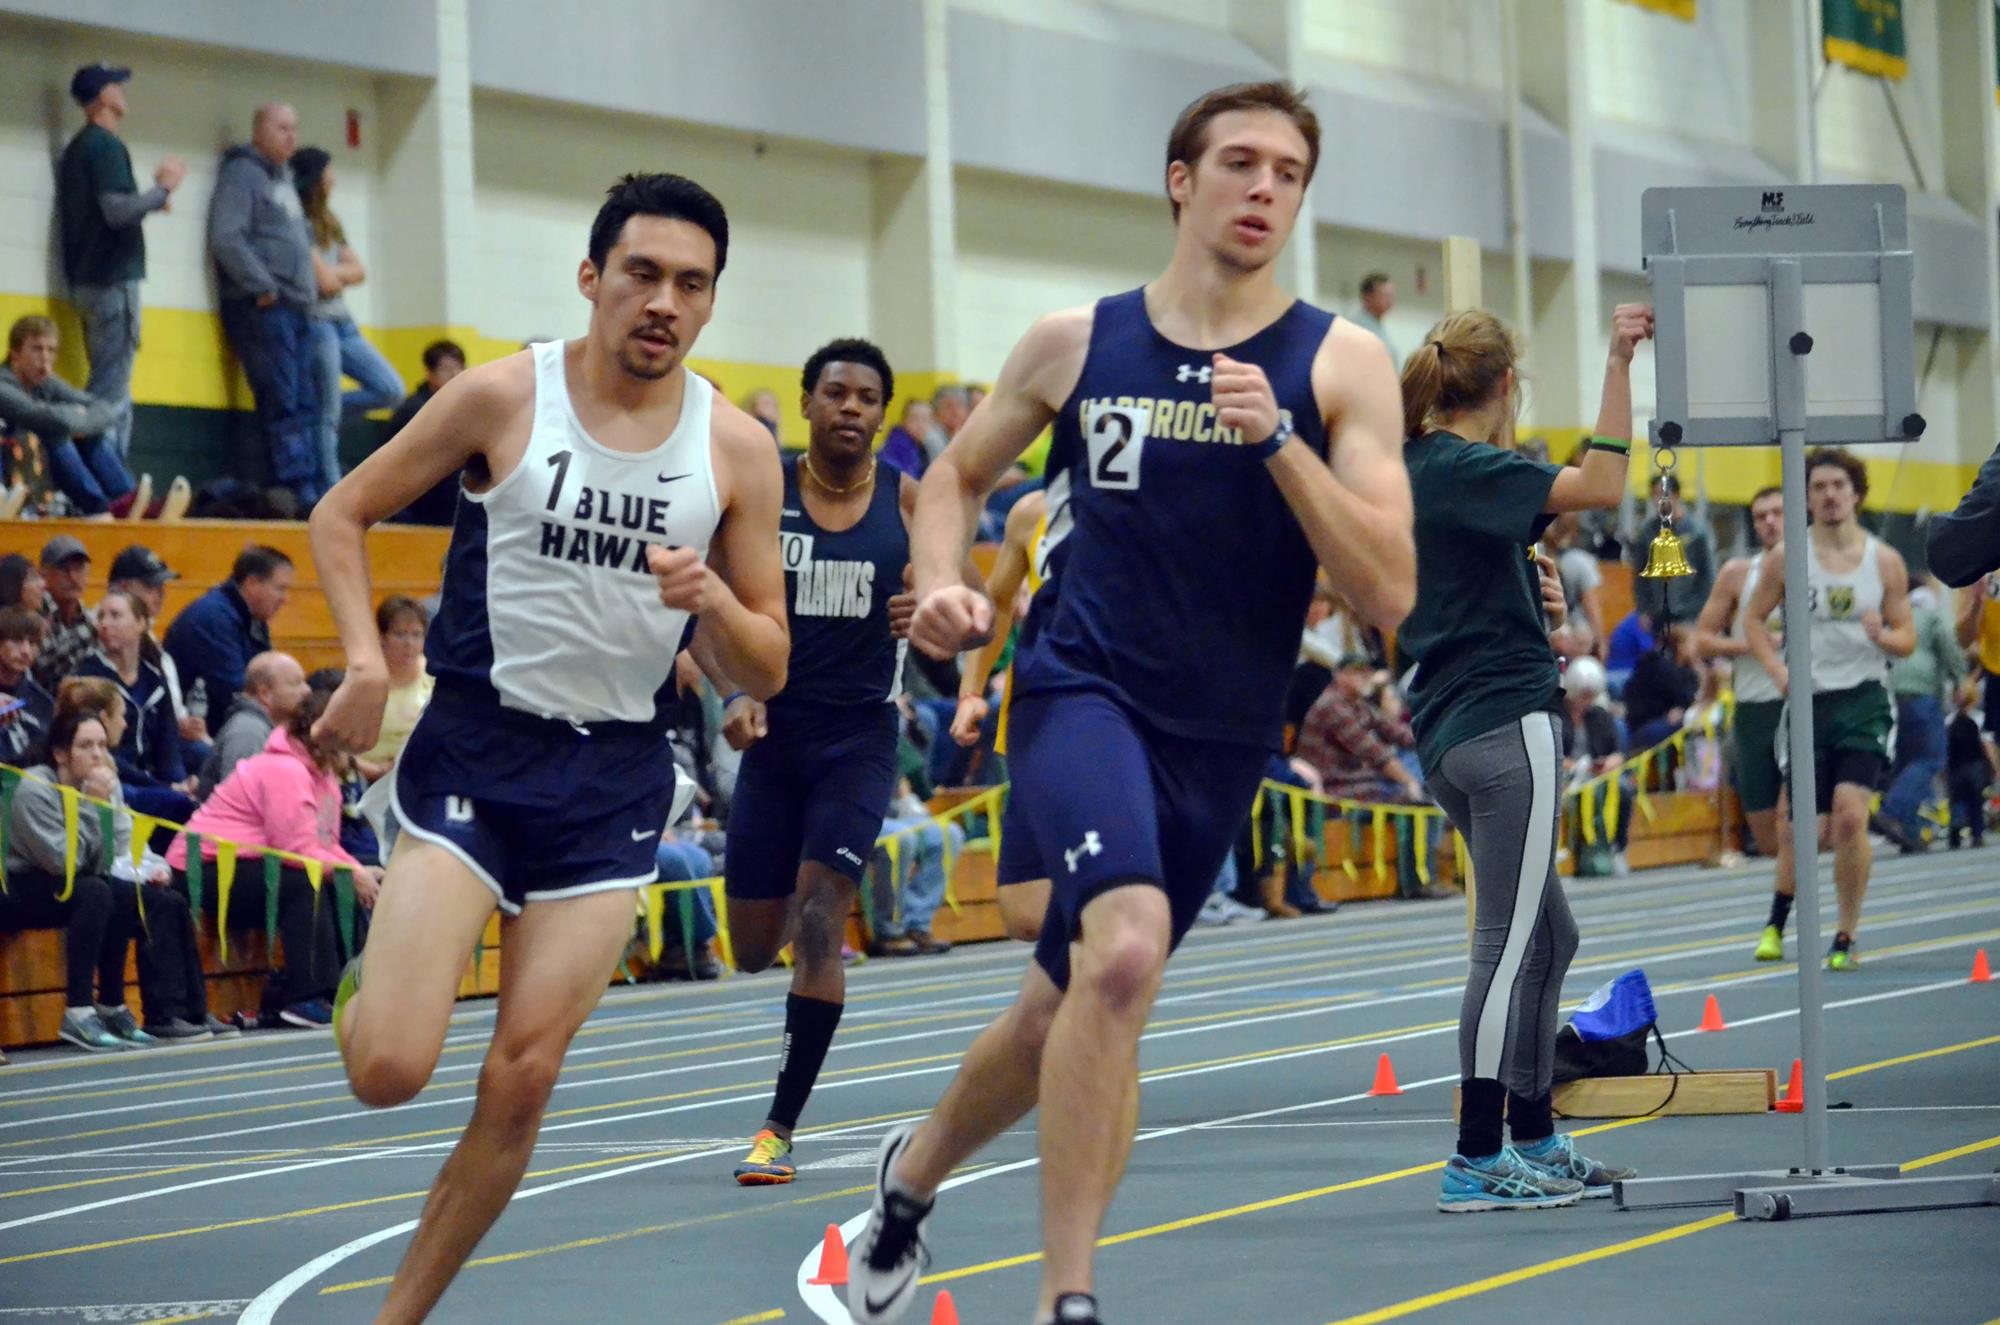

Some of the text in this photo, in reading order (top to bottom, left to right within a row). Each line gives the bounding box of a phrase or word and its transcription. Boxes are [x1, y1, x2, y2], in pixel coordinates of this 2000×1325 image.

[1094, 412, 1133, 482] 2
[546, 450, 572, 512] 1
[574, 486, 671, 535] BLUE
[540, 521, 681, 575] HAWK
[795, 559, 876, 619] HAWKS
